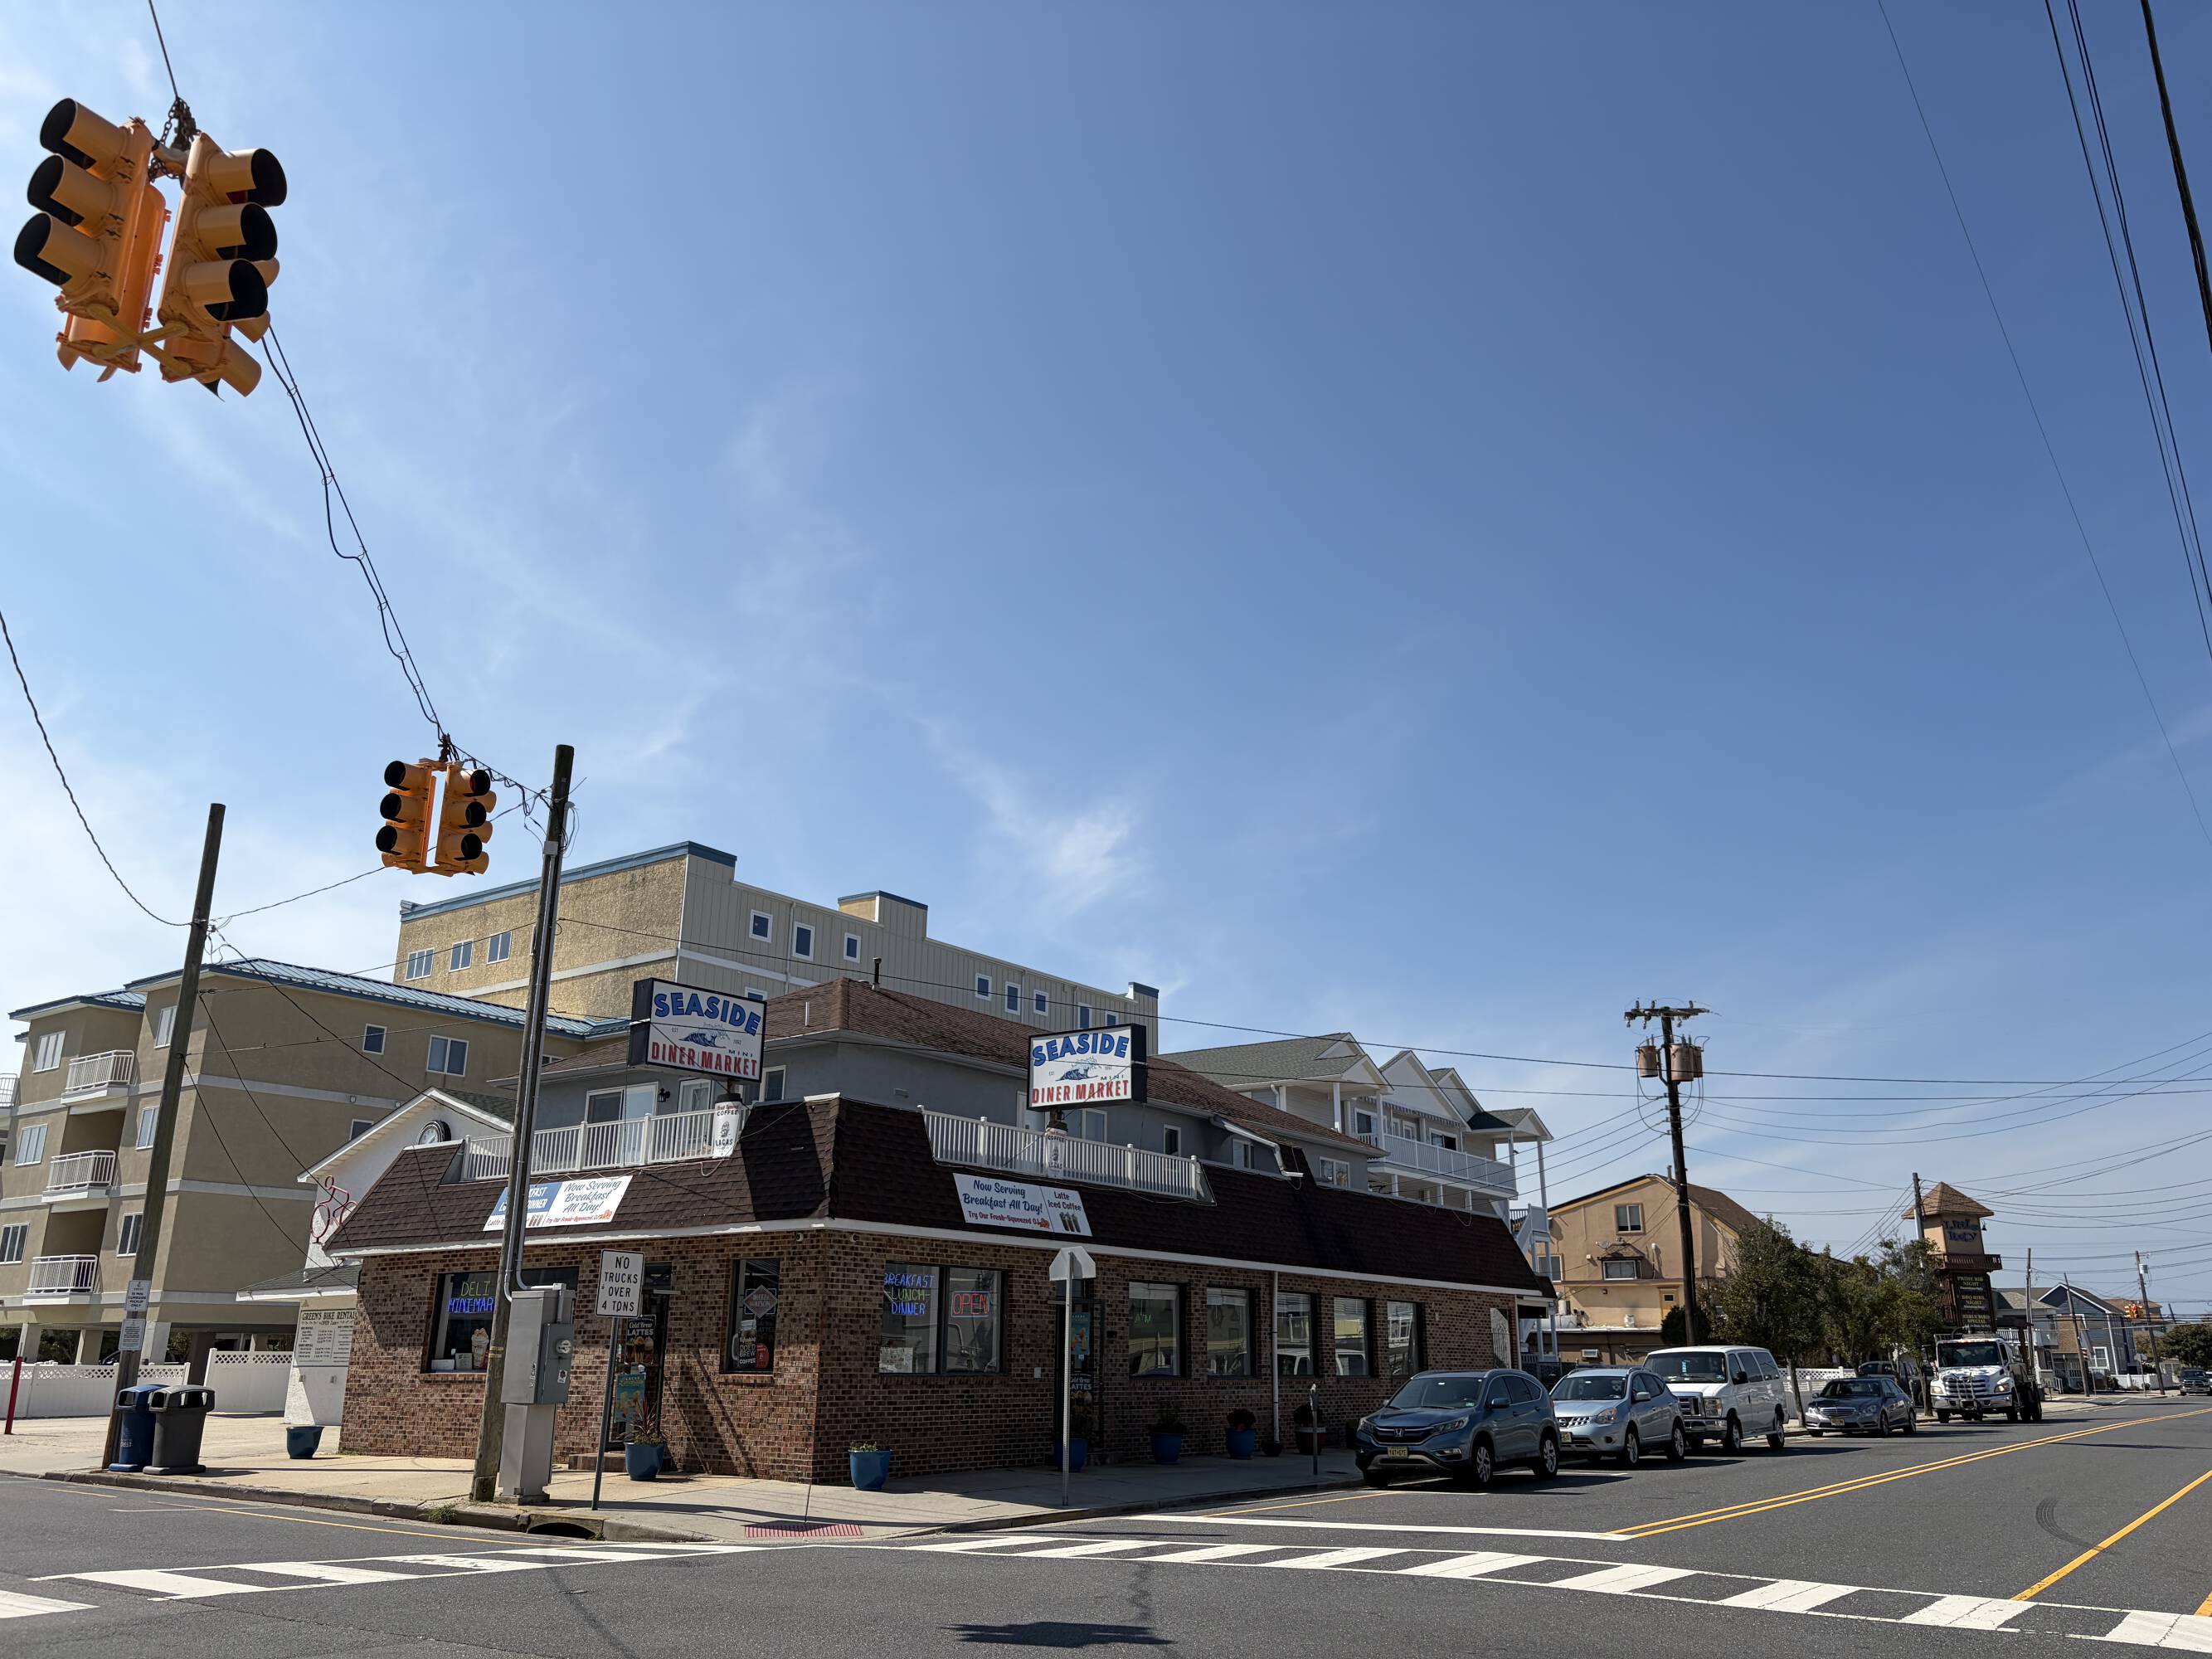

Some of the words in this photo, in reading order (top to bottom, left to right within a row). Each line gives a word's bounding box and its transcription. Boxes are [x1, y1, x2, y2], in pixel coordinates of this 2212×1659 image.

[654, 992, 761, 1036] SEASIDE
[728, 1049, 753, 1058] MINI
[1032, 1033, 1129, 1067] SEASIDE
[651, 1042, 695, 1067] DINER
[701, 1051, 756, 1076] MARKET
[1032, 1085, 1071, 1103] DINER
[1075, 1080, 1129, 1100] MARKET
[528, 1187, 548, 1197] KFAST
[564, 1182, 585, 1193] Now
[586, 1180, 622, 1191] Serving
[973, 1180, 992, 1192] Now
[994, 1182, 1025, 1199] Serving
[564, 1190, 612, 1203] Breakfast
[1053, 1191, 1070, 1200] Latte
[563, 1203, 577, 1213] All
[580, 1201, 604, 1212] Day!
[962, 1193, 1006, 1209] Breakfast
[1009, 1199, 1020, 1209] All
[1023, 1201, 1043, 1215] Day!
[1048, 1200, 1061, 1209] Iced
[1062, 1202, 1082, 1211] Coffee
[968, 1210, 978, 1219] Try
[615, 1256, 630, 1269] NO
[605, 1272, 638, 1284] TRUCKS
[883, 1273, 935, 1287] BREAKFAST
[461, 1281, 491, 1297] DELI
[608, 1286, 631, 1297] OVER
[448, 1297, 494, 1313] MINI-MAR
[601, 1300, 607, 1311] 4
[612, 1301, 634, 1311] TONS
[892, 1301, 926, 1315] DINNER
[952, 1293, 989, 1315] OPEN
[302, 1312, 322, 1321] GREEN'S
[323, 1311, 335, 1320] BIKE
